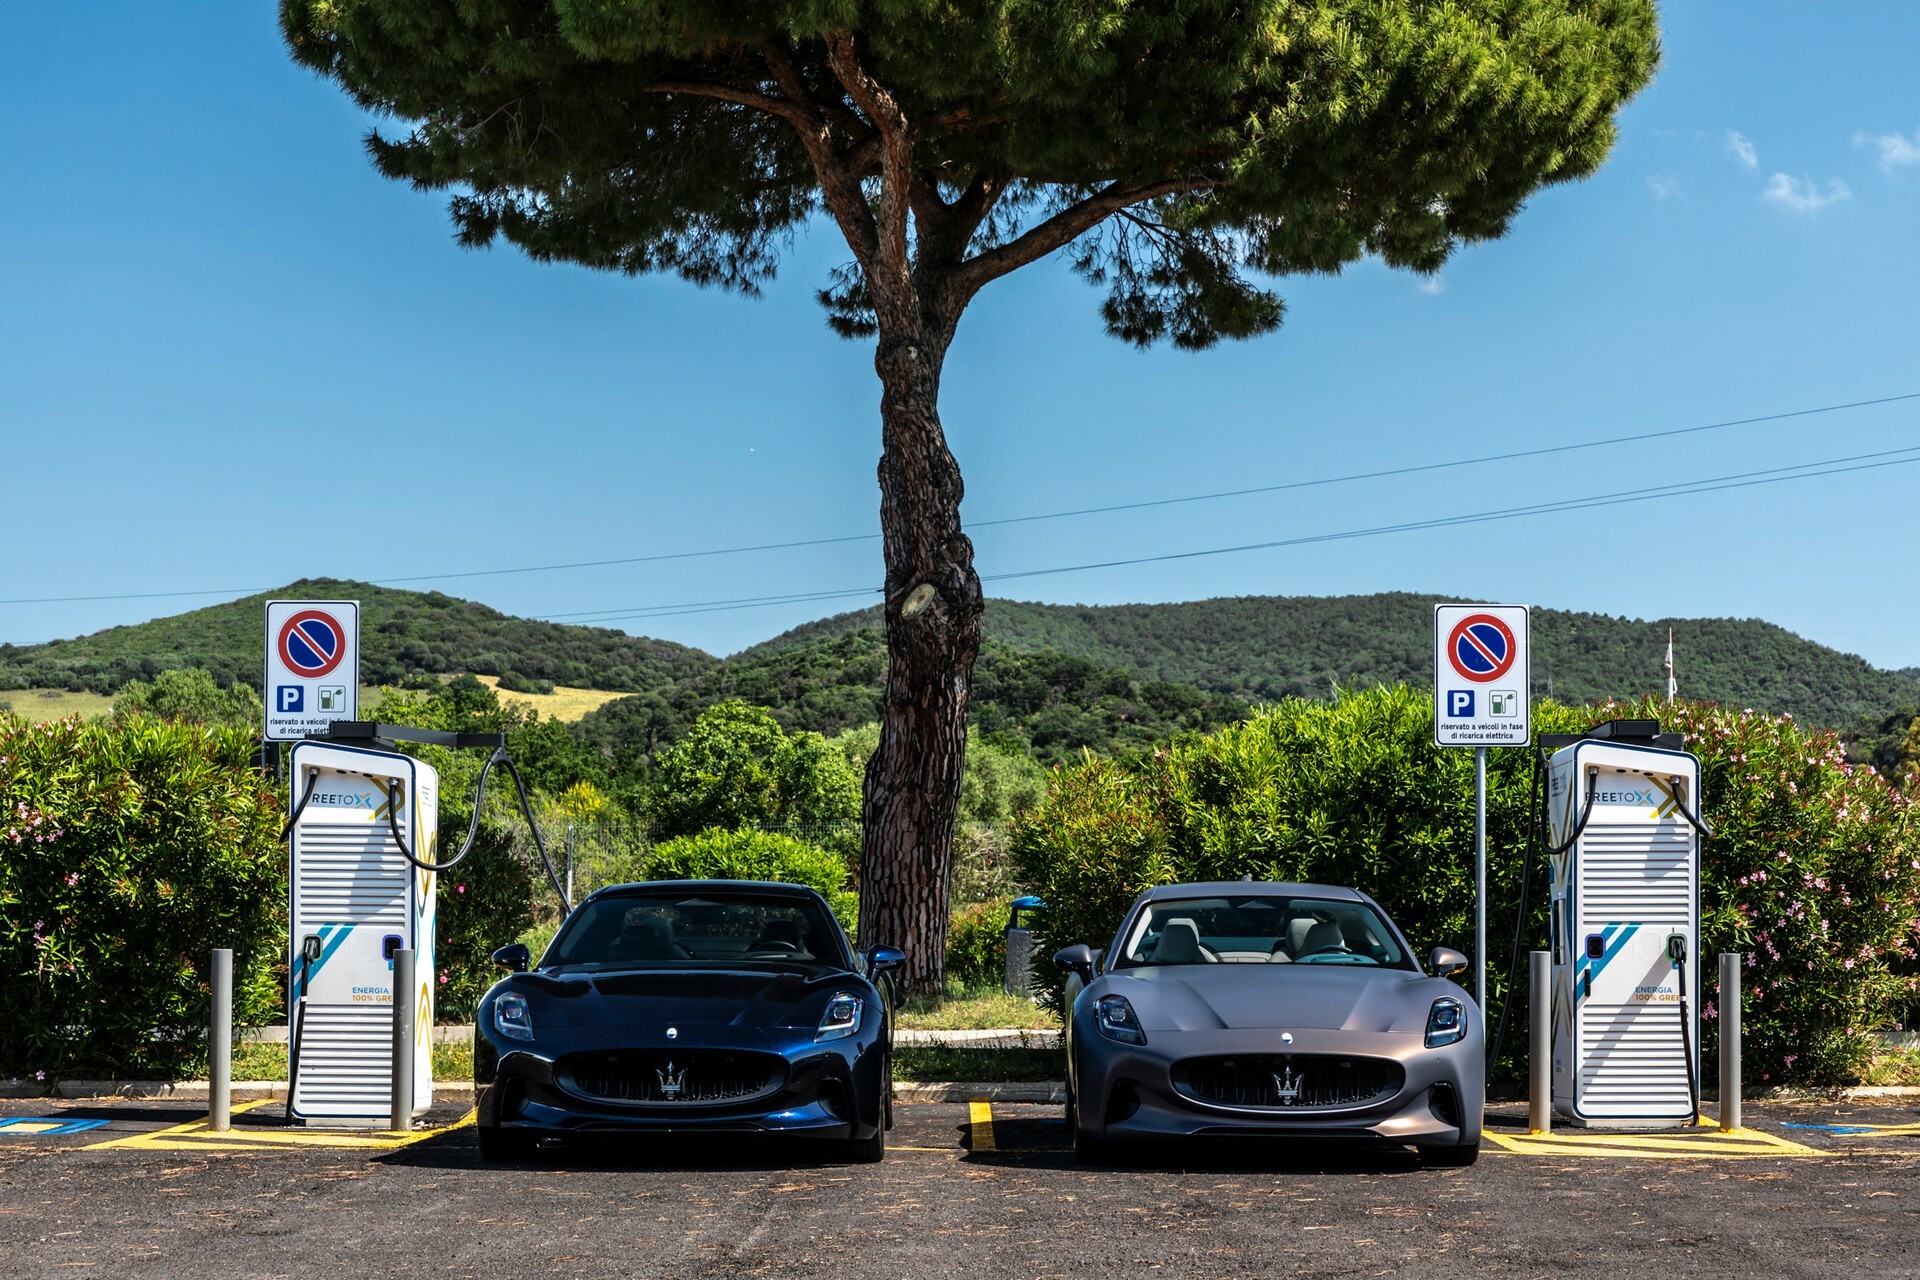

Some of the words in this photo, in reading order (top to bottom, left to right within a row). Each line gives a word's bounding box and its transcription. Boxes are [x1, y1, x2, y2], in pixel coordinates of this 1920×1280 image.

[283, 688, 299, 710] P
[1453, 692, 1470, 715] P
[1635, 986, 1672, 994] ENERGIA
